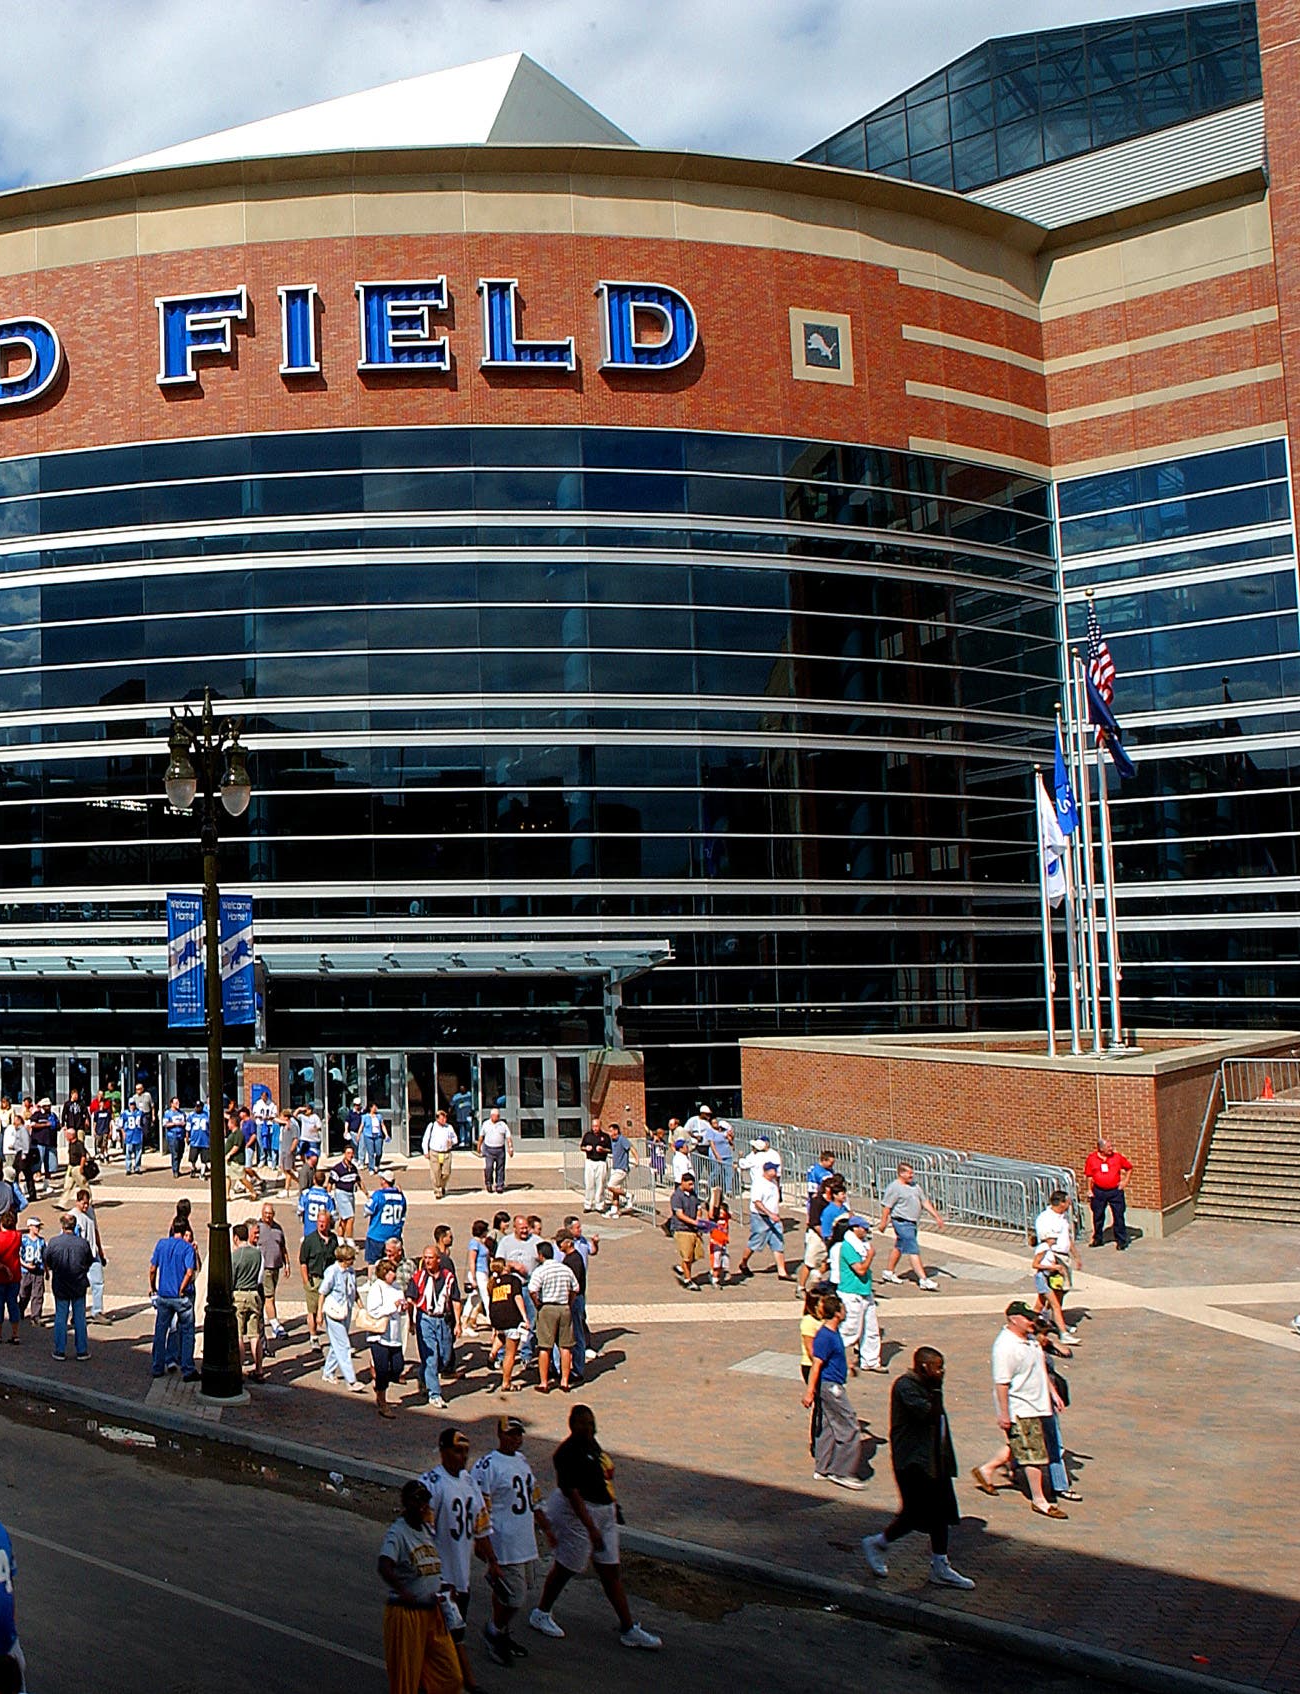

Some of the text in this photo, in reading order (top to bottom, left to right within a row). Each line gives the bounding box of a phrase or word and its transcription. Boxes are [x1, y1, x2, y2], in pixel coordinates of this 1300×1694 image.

[155, 275, 698, 385] FIELD
[170, 899, 200, 910] Welcome
[222, 901, 251, 911] Welcome
[381, 1203, 403, 1224] 20
